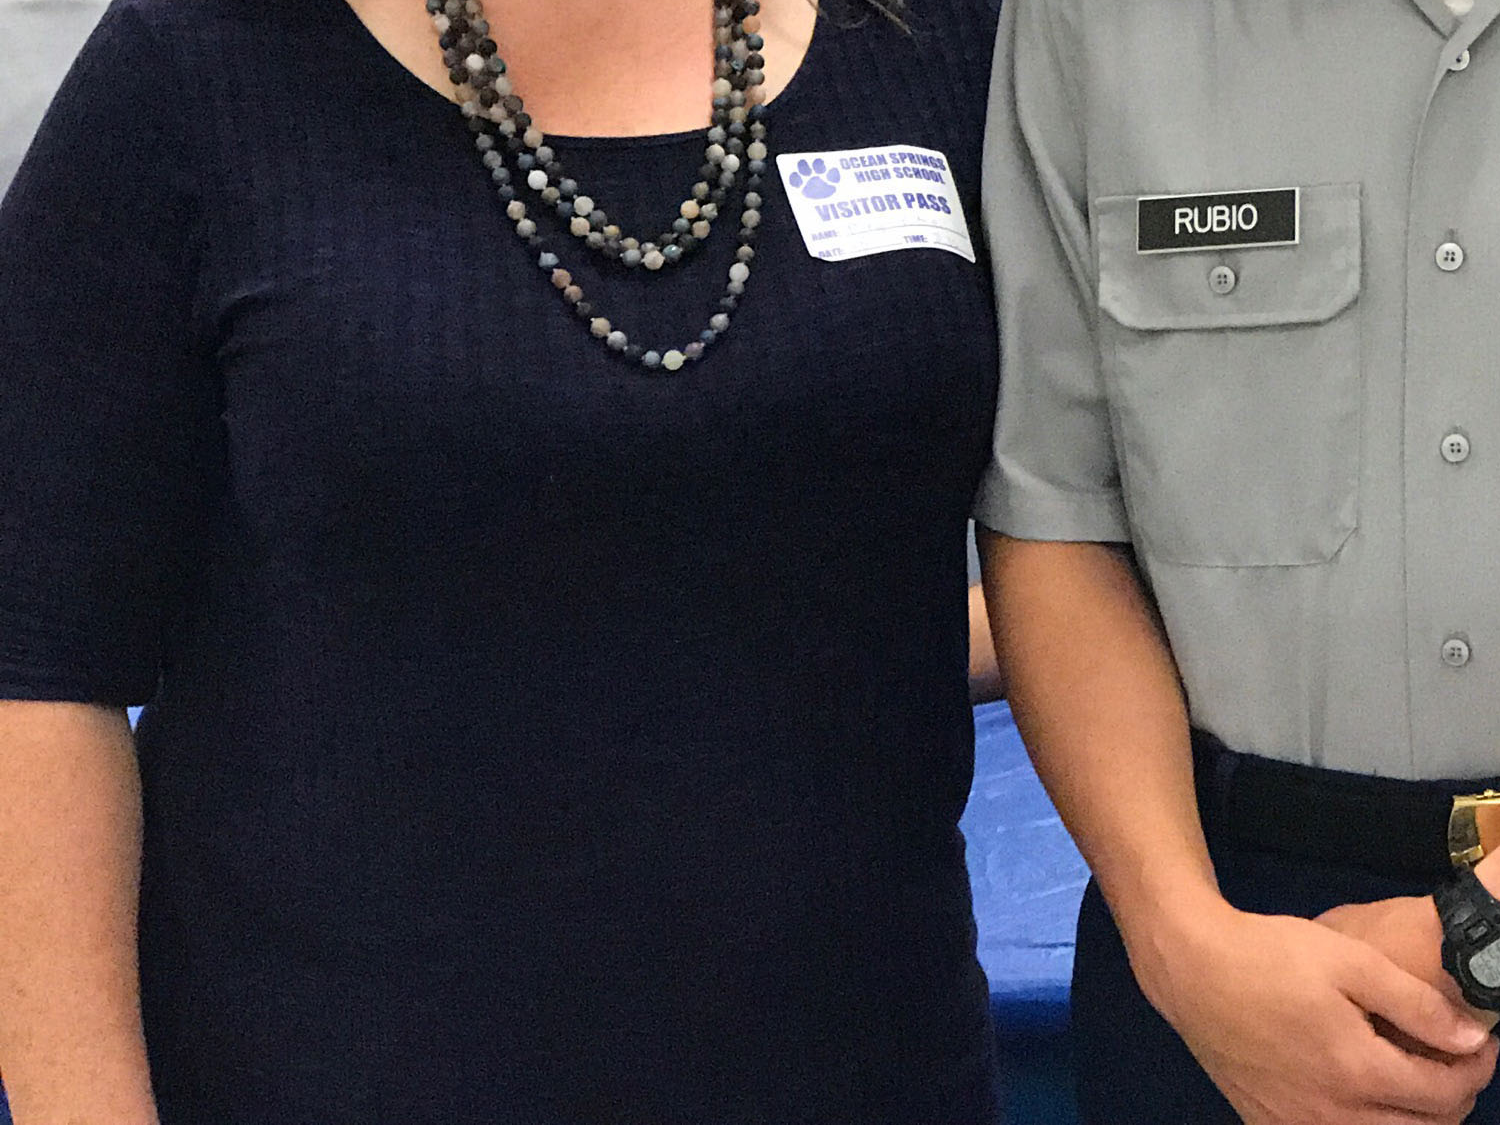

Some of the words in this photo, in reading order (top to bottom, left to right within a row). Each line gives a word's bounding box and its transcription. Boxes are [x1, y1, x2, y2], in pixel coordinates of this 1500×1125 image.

[839, 154, 889, 171] OCEAN
[891, 152, 947, 172] SPRINGS
[853, 168, 892, 184] HIGH
[895, 166, 946, 185] SCHOOL
[814, 195, 903, 222] VISITOR
[902, 192, 952, 216] PASS
[1174, 203, 1258, 234] RUBIO
